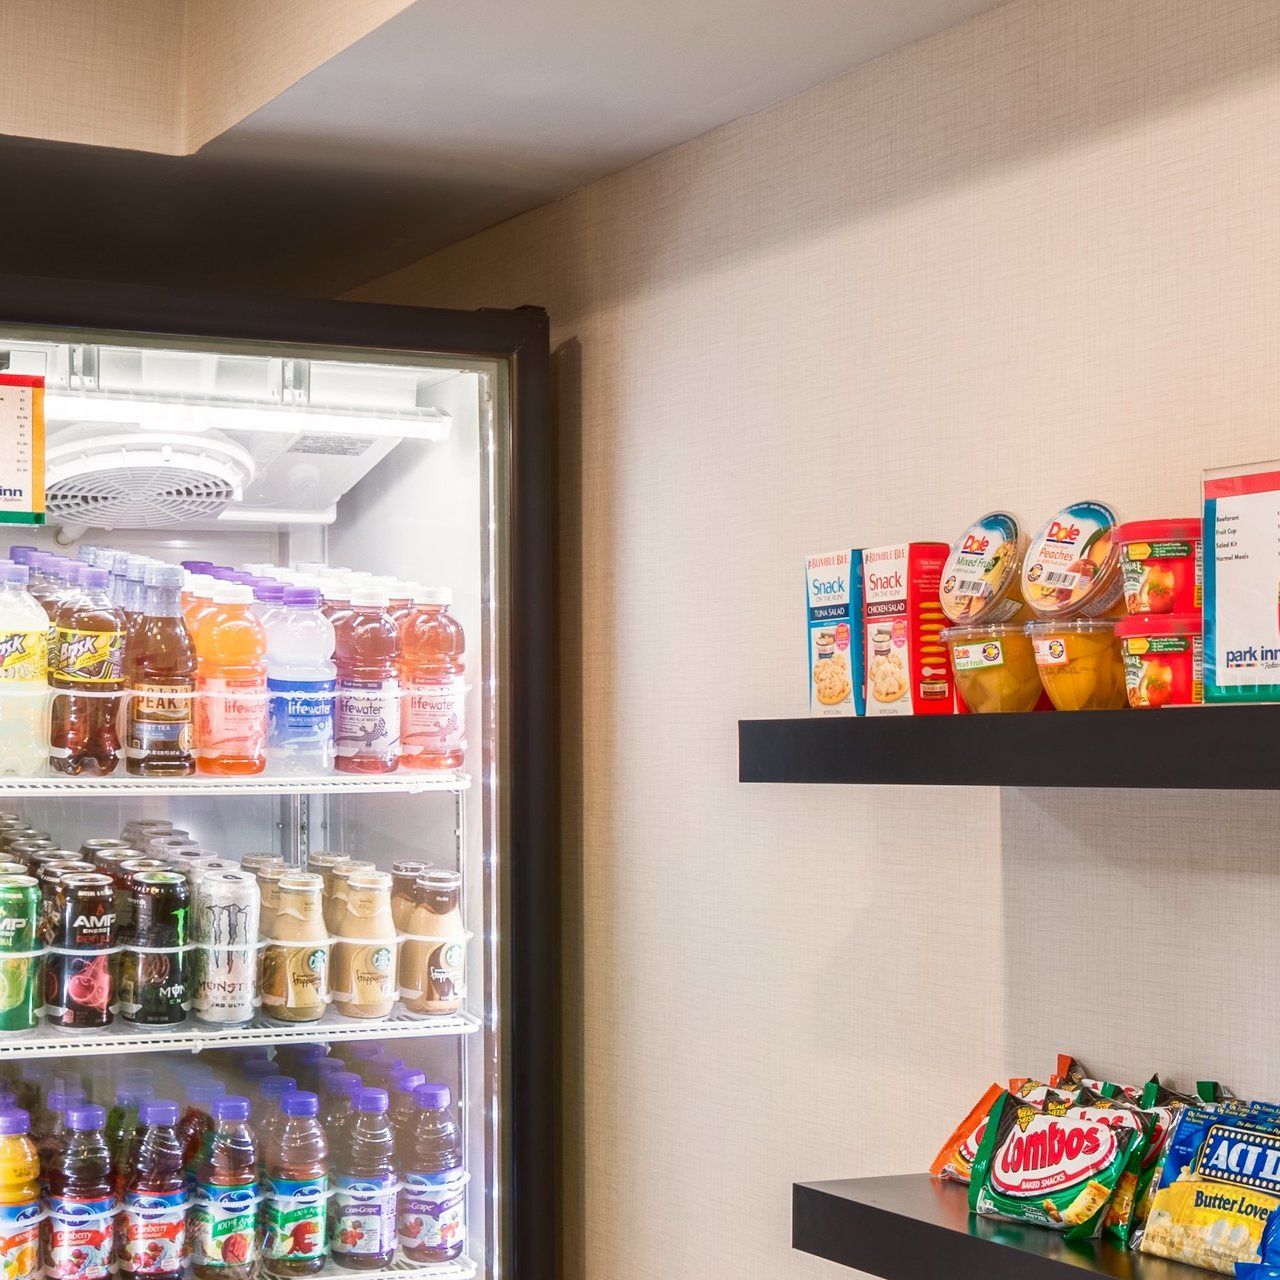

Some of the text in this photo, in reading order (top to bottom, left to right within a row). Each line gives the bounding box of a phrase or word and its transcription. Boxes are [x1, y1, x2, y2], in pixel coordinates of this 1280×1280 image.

[1215, 527, 1237, 536] Fruit Cup
[1215, 553, 1249, 562] Hormel Meals
[812, 576, 845, 595] Snack
[869, 571, 902, 591] Snack
[1226, 646, 1258, 668] park
[73, 914, 117, 928] AMP
[1001, 1121, 1102, 1174] Combos
[1207, 1139, 1262, 1176] ACT
[1041, 1173, 1066, 1187] SNACKS
[1194, 1190, 1235, 1212] Butter
